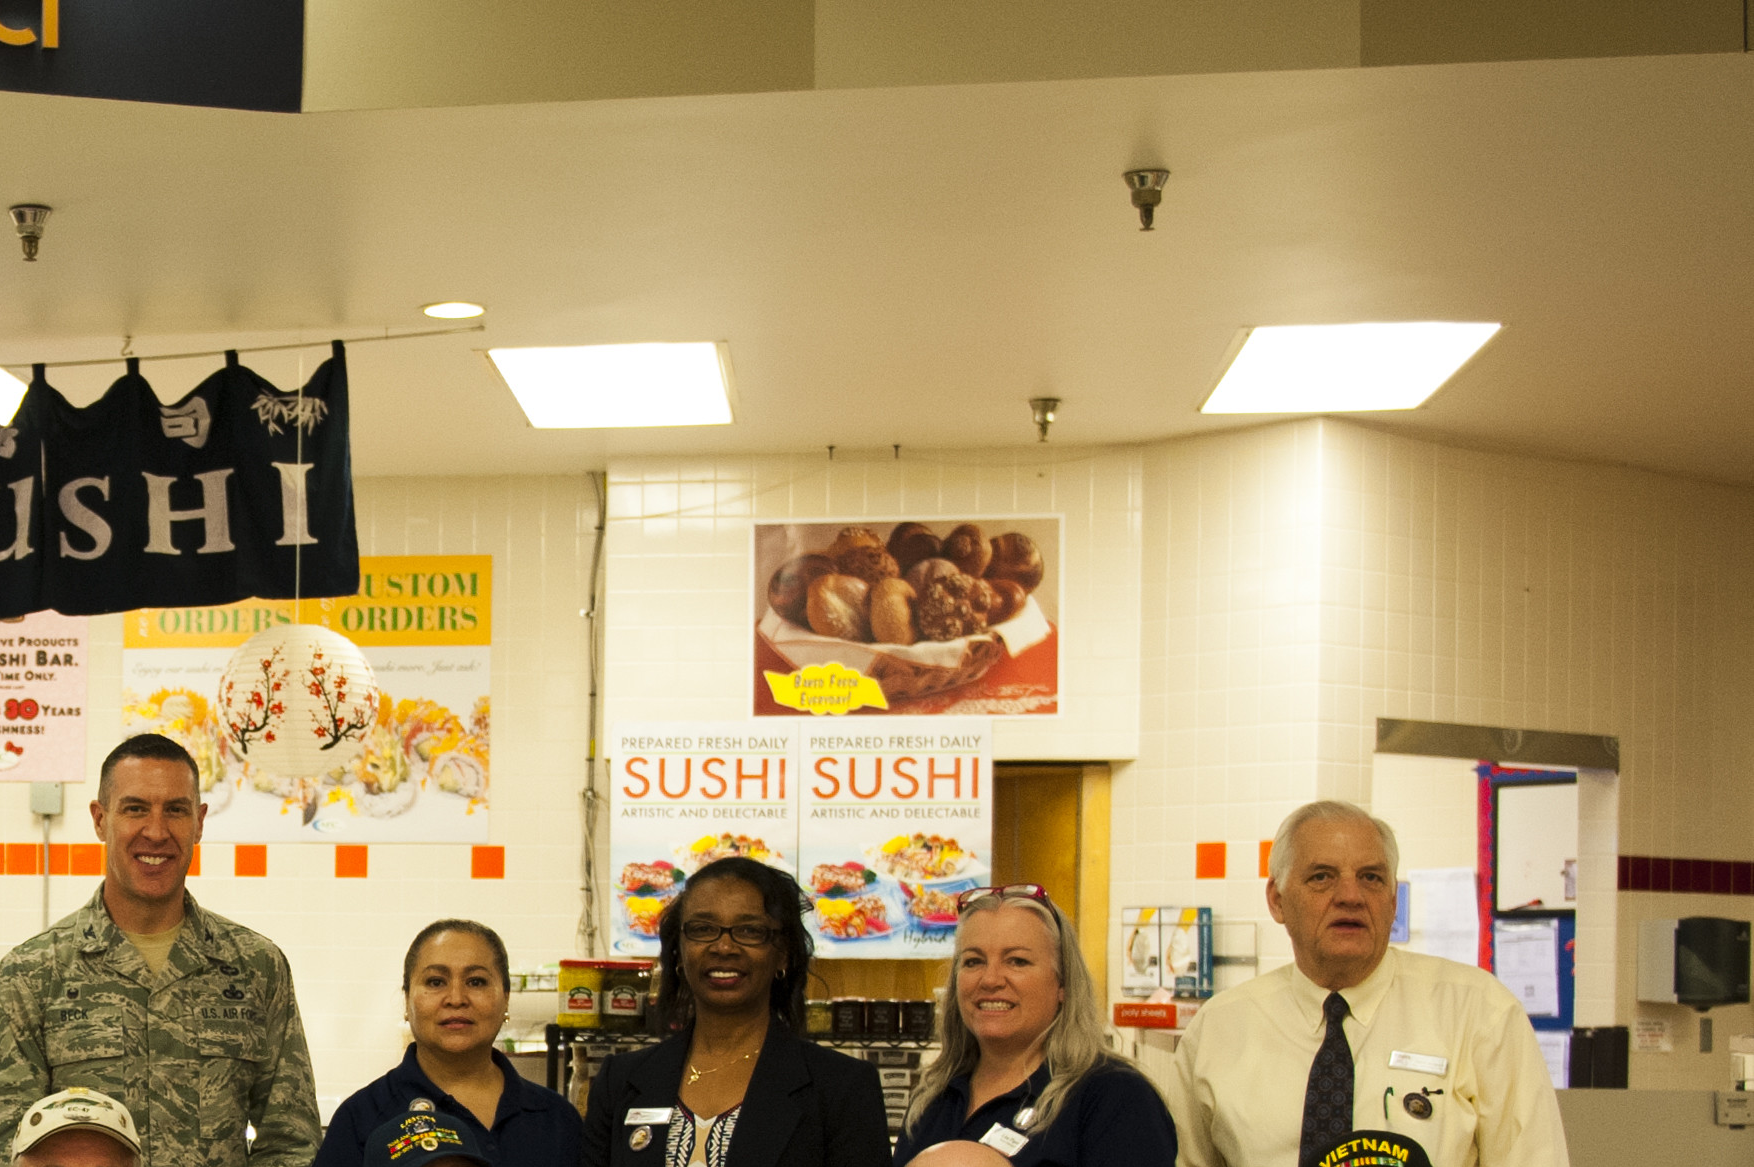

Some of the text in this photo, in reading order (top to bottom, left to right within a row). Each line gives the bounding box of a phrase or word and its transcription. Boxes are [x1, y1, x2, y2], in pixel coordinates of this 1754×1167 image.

[364, 572, 479, 598] USTOM
[159, 607, 293, 635] ORDERS
[341, 605, 479, 632] ORDERS
[18, 636, 79, 647] PRODUCTS
[35, 650, 79, 667] BAR.
[24, 671, 57, 682] ONLY.
[4, 698, 40, 721] 30
[41, 705, 82, 718] YEARS
[621, 736, 789, 750] PREPARED FRESH DAILY
[810, 735, 981, 750] PREPARED FRESH DAILY
[622, 757, 787, 800] SUSHI
[811, 757, 980, 800] SUSHI
[621, 807, 788, 820] ARTISTIC AND DELECTABLE
[810, 807, 981, 820] ARTISTIC AND DELECTABLE
[903, 928, 947, 949] Hybrid
[60, 1008, 88, 1022] BECK
[201, 1007, 221, 1019] U.S.
[223, 1007, 239, 1019] AIR
